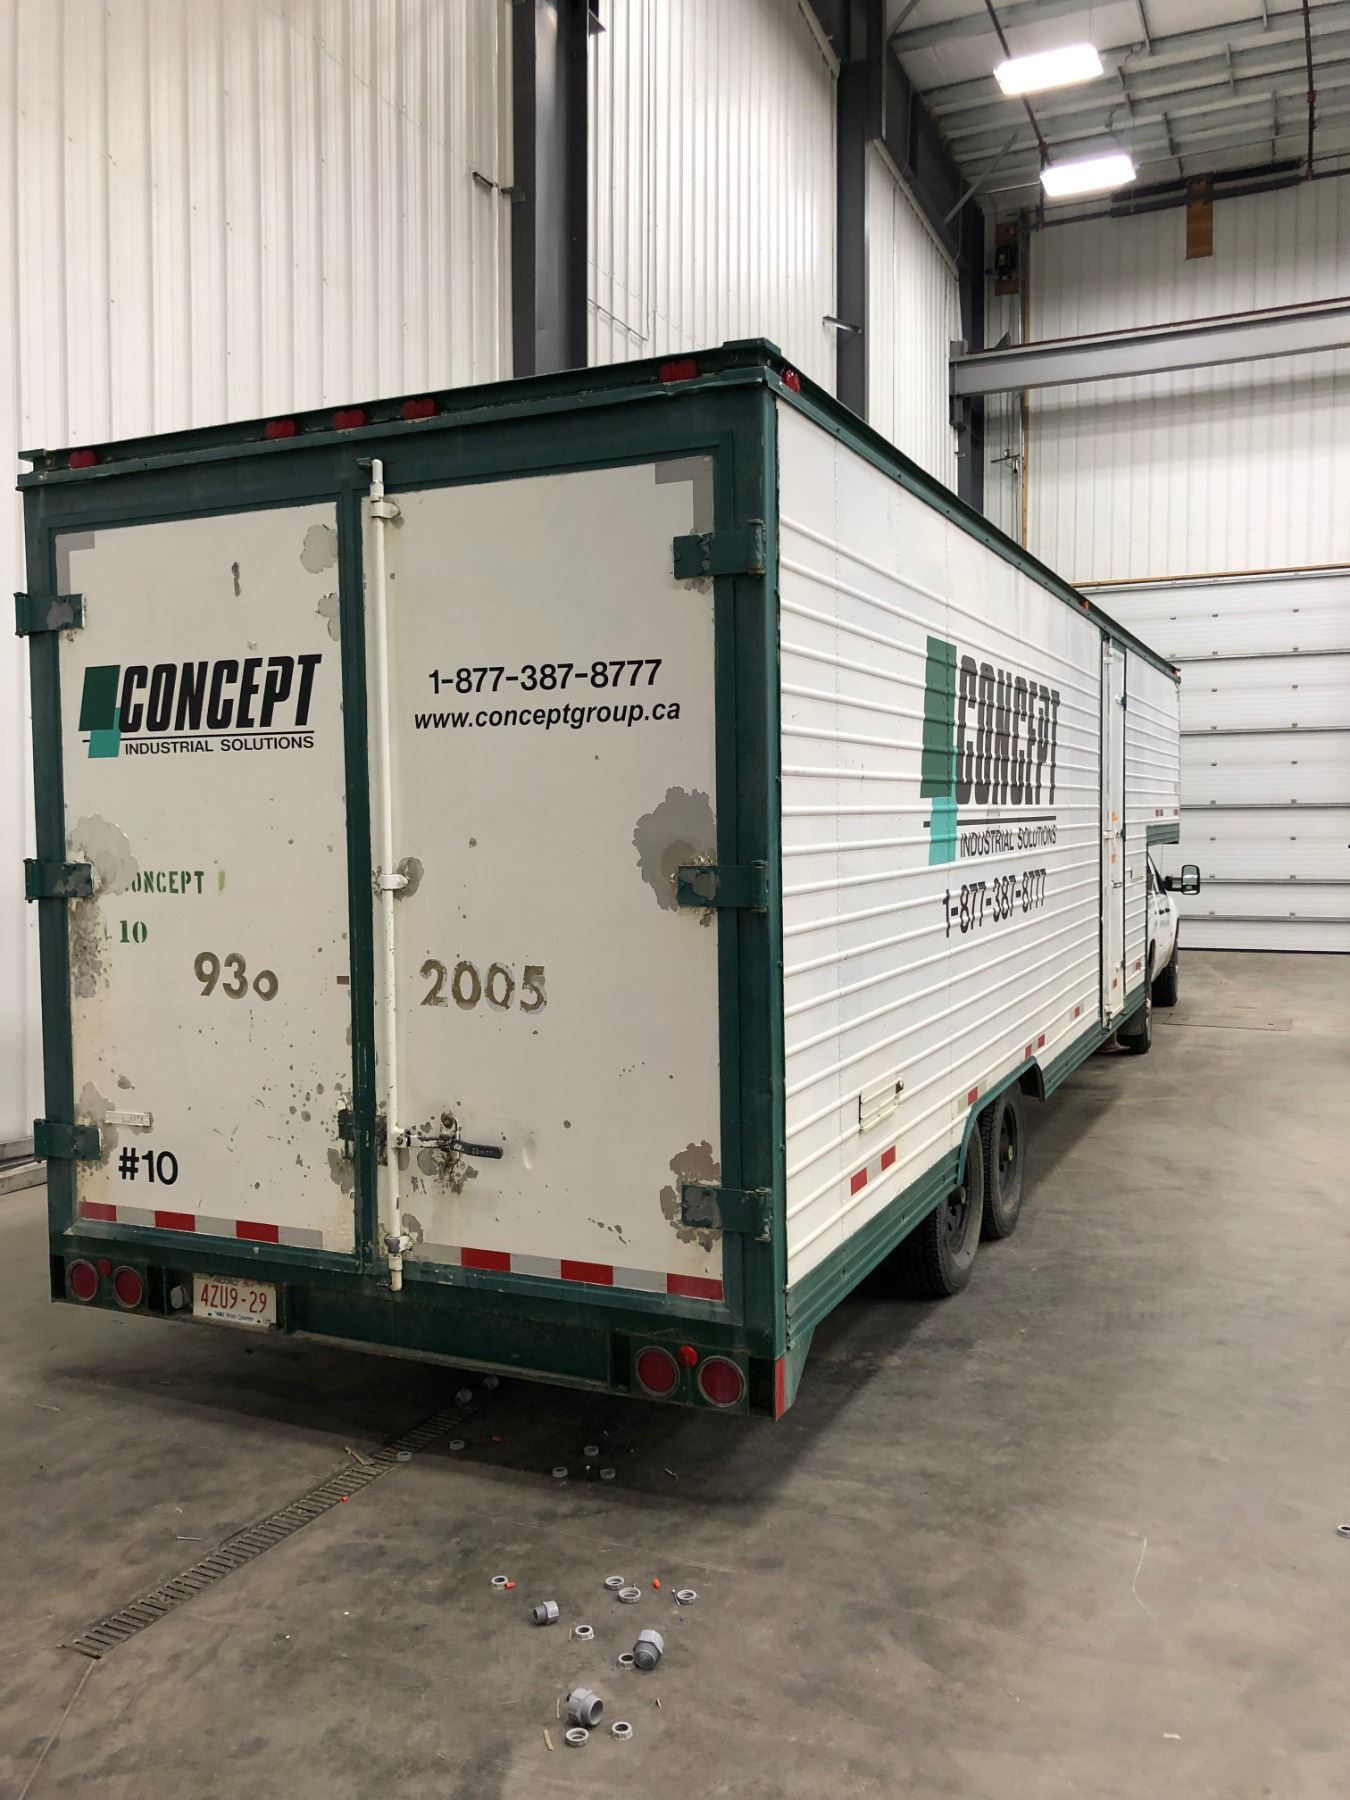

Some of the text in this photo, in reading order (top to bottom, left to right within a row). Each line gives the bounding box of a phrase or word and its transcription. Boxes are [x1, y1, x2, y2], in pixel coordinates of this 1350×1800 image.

[119, 654, 322, 733] CONCEPT
[428, 659, 662, 694] 1-877-387-8777
[414, 702, 681, 730] www.conceptgroup.ca
[956, 654, 1060, 805] CONCEPT
[125, 735, 314, 755] INDUSTRIAL SOLUTIONS
[960, 824, 1056, 858] INDUSTRIAL SOLUTIONS
[125, 870, 204, 894] ONCEPT
[943, 869, 1046, 938] 1-877-387-8777
[120, 920, 148, 943] 10
[420, 959, 547, 1014] 2005
[118, 1147, 178, 1185] #10
